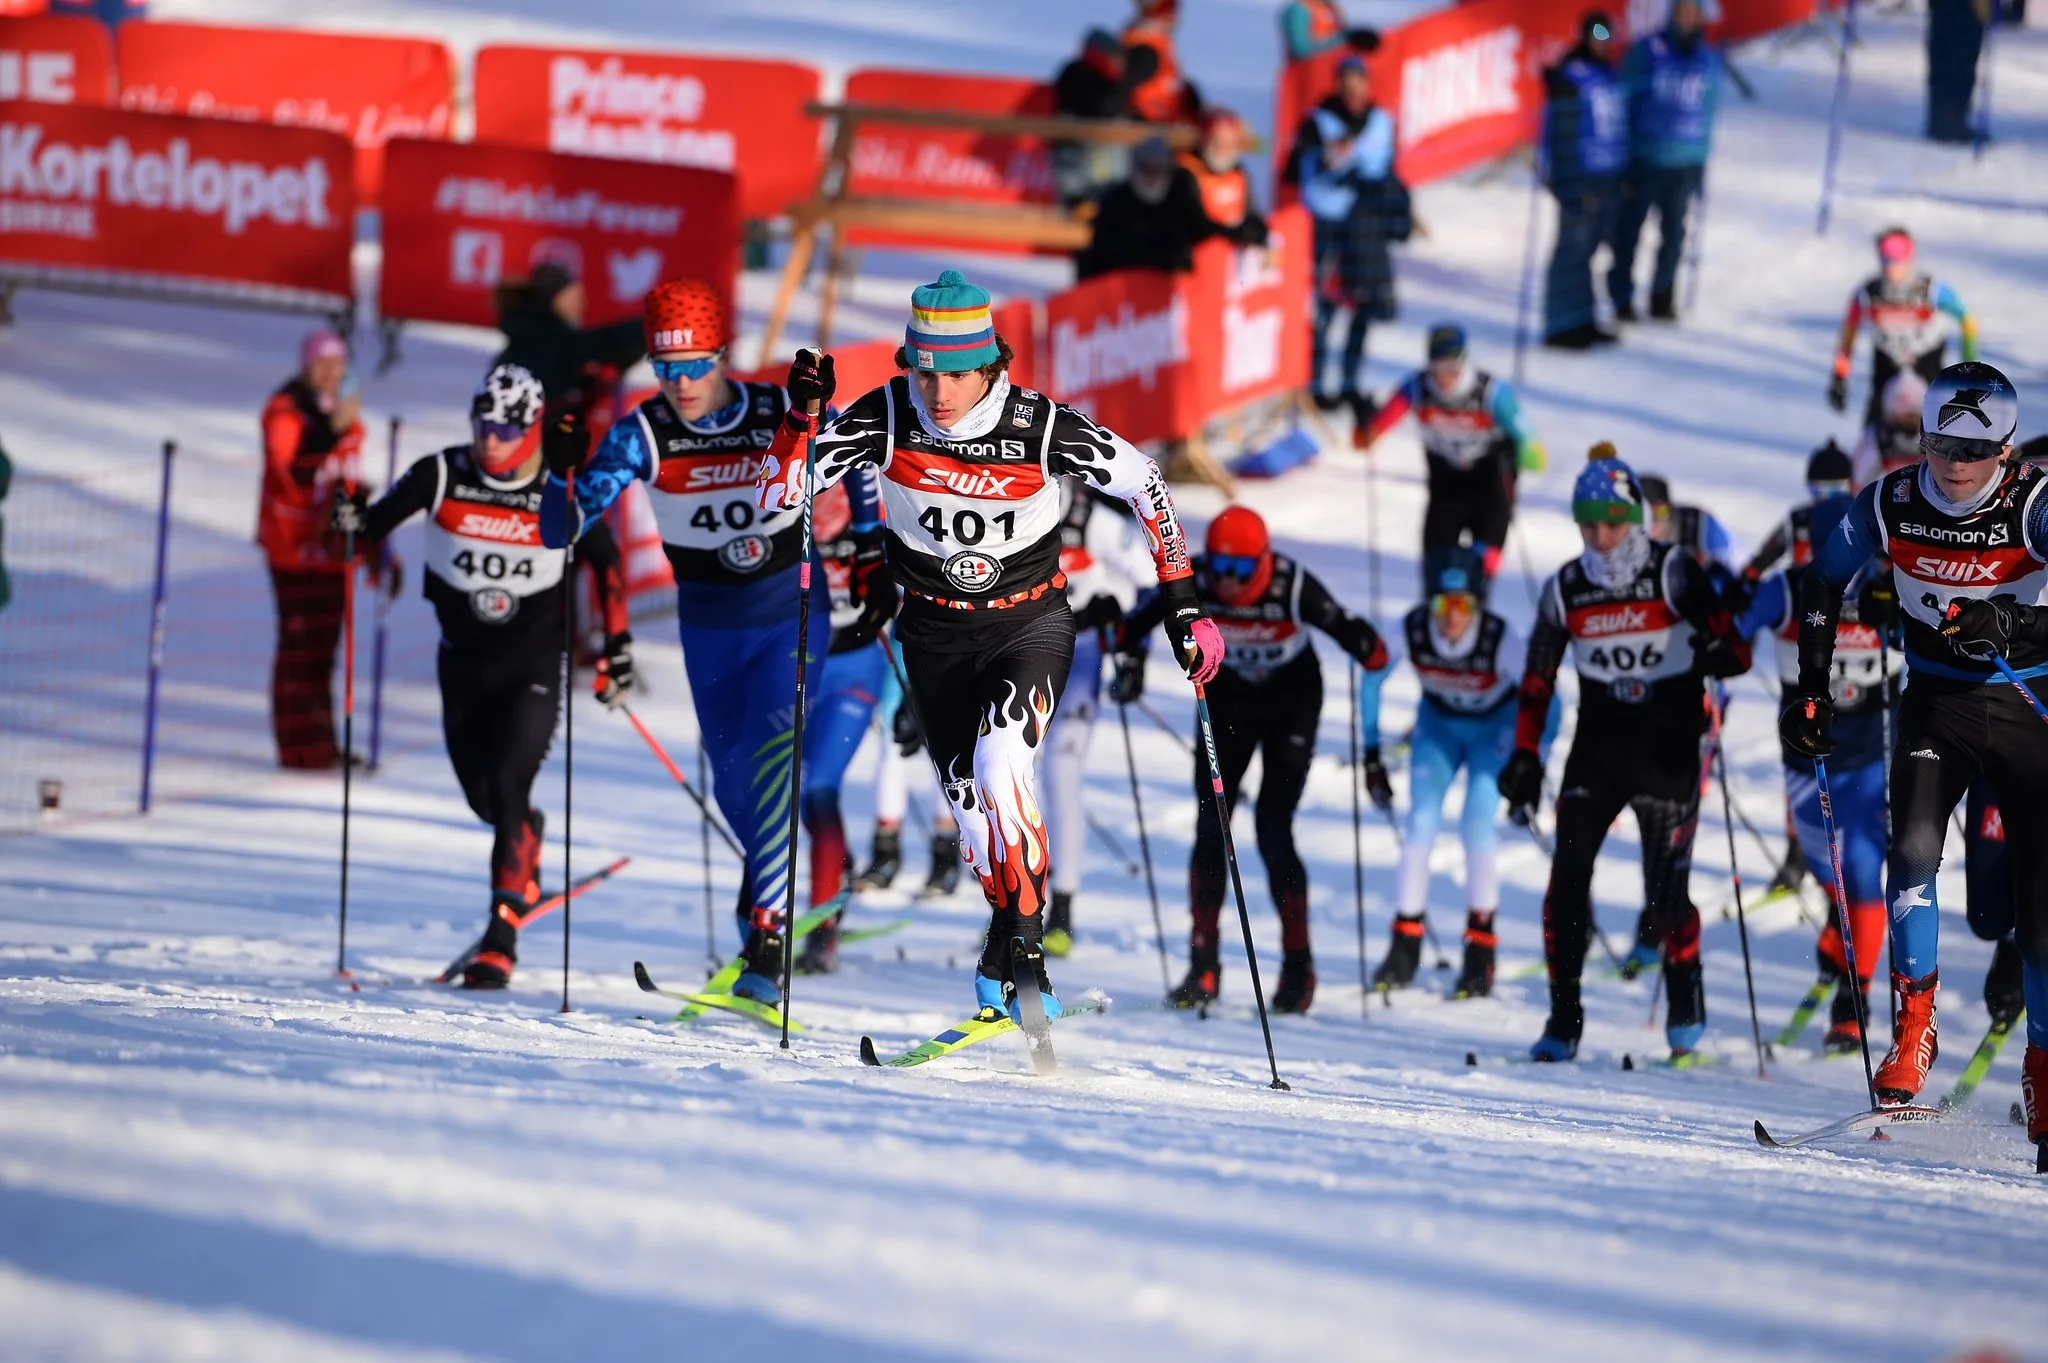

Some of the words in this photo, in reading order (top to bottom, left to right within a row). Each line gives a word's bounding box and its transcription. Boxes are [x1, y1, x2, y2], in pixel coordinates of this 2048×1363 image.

[549, 57, 706, 121] Prince
[0, 123, 331, 235] Kortelopet
[654, 330, 694, 347] RUBY
[1016, 404, 1032, 414] US
[690, 500, 781, 532] 40
[918, 506, 1016, 546] 401
[453, 549, 534, 579] 404
[1942, 625, 1960, 637] TOKO
[1590, 643, 1663, 671] 406
